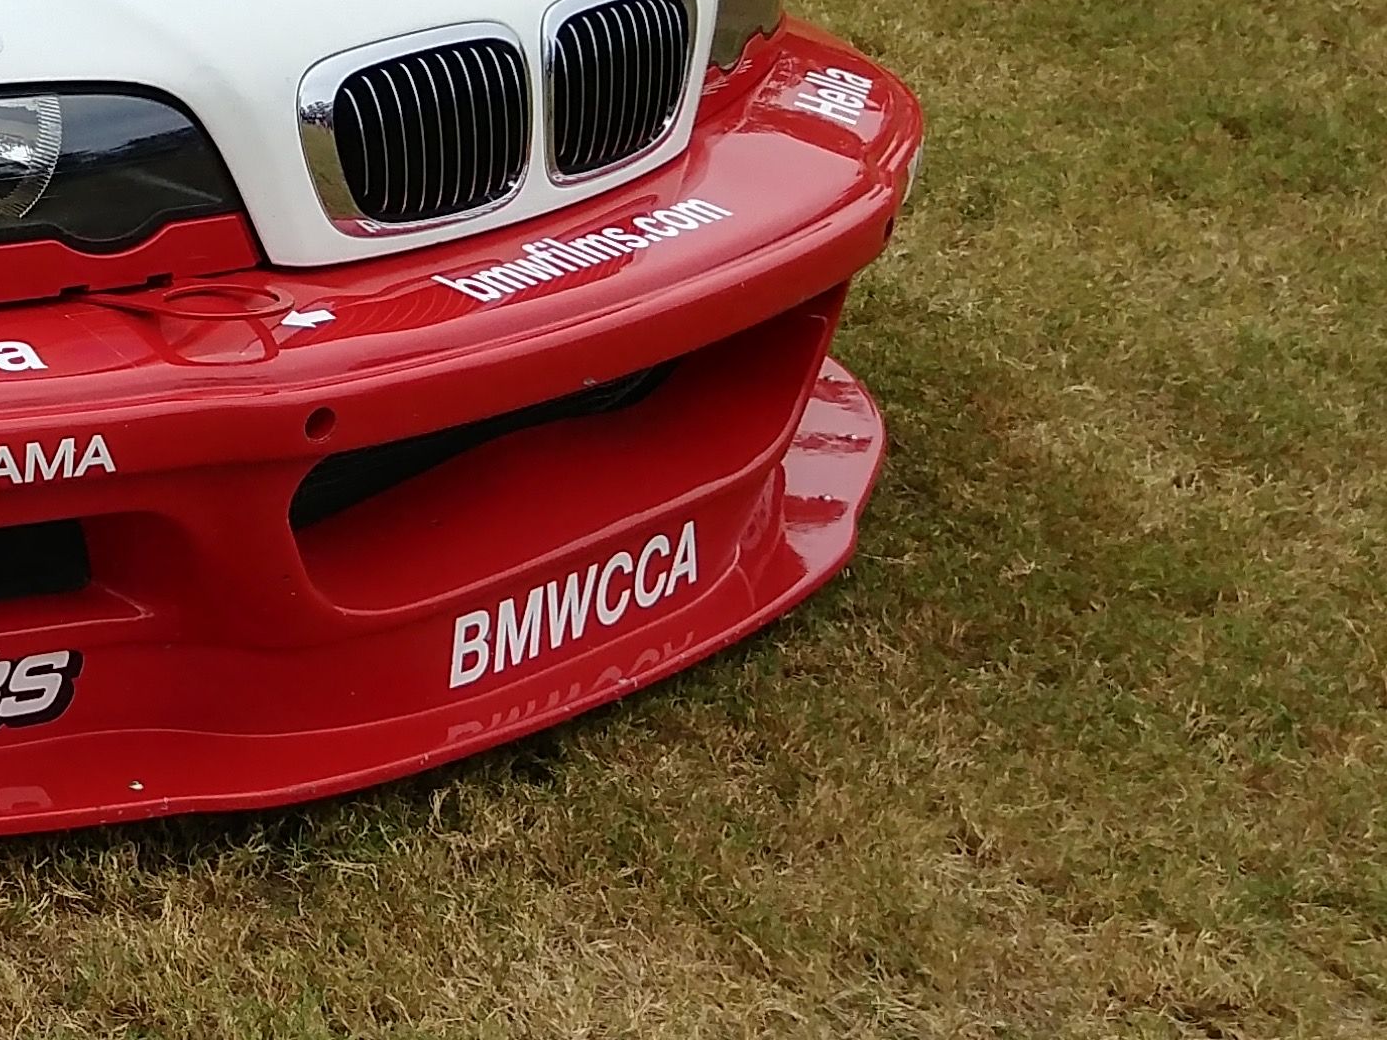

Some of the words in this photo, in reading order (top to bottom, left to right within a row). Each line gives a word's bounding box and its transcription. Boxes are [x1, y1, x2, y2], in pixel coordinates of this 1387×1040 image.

[794, 67, 873, 125] Hella
[431, 198, 733, 302] bmwfilms.com
[449, 520, 697, 689] BMWCCA
